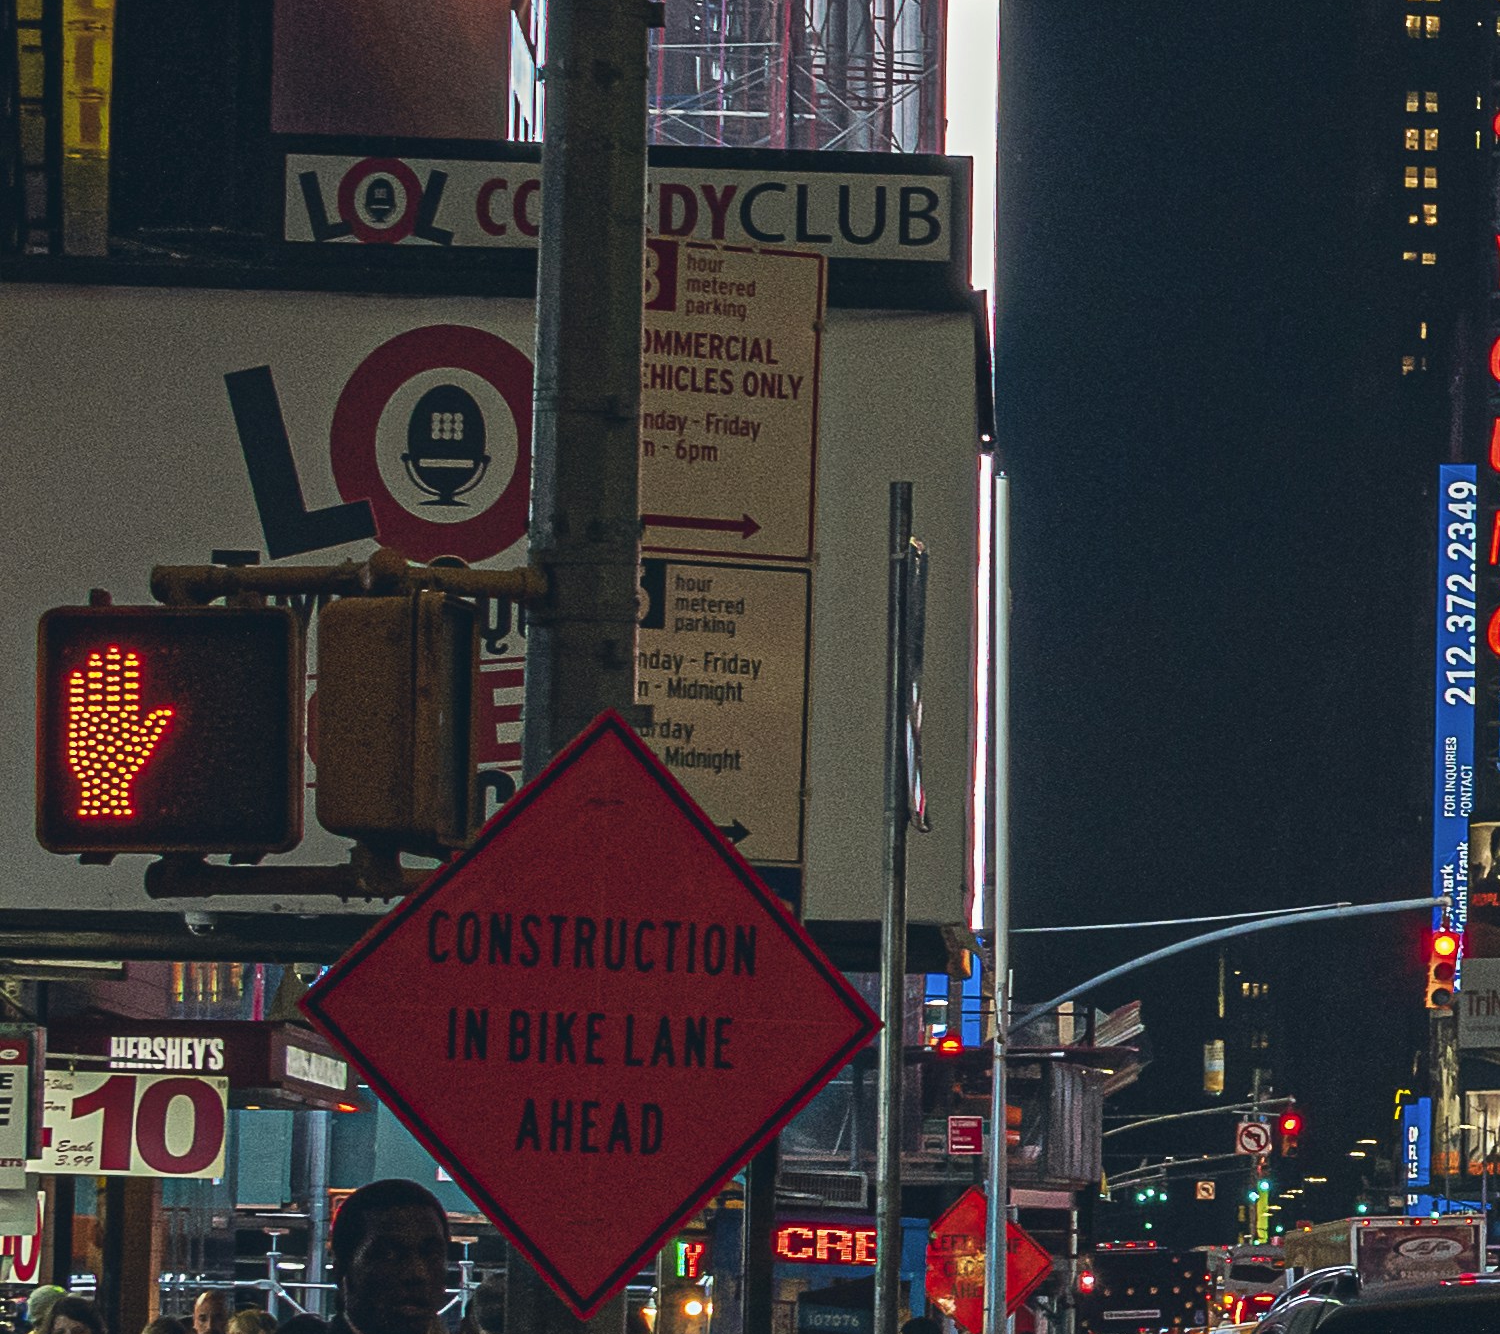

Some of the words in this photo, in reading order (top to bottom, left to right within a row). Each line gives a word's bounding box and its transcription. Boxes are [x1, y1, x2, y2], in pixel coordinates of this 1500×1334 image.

[687, 254, 724, 273] hour
[687, 278, 756, 297] metered
[686, 299, 747, 322] parking
[743, 371, 804, 400] ONLY
[705, 413, 761, 442] Friday
[676, 439, 718, 463] 6pm
[675, 575, 713, 593] hour
[1444, 479, 1478, 707] 212.372.2349
[675, 597, 745, 616] metered
[675, 617, 736, 637] parking
[704, 652, 762, 680] Friday
[667, 679, 743, 703] Midnight
[665, 747, 741, 771] Midnight
[428, 909, 757, 976] CONSTRUCTION
[448, 1008, 488, 1061] IN
[509, 1009, 605, 1067] BIKE
[624, 1013, 735, 1070] LANE
[110, 1037, 225, 1070] HERSHEY'S
[71, 1075, 225, 1174] 10
[515, 1098, 664, 1156] AHEAD
[56, 1140, 94, 1153] Each
[55, 1155, 95, 1167] 3.99
